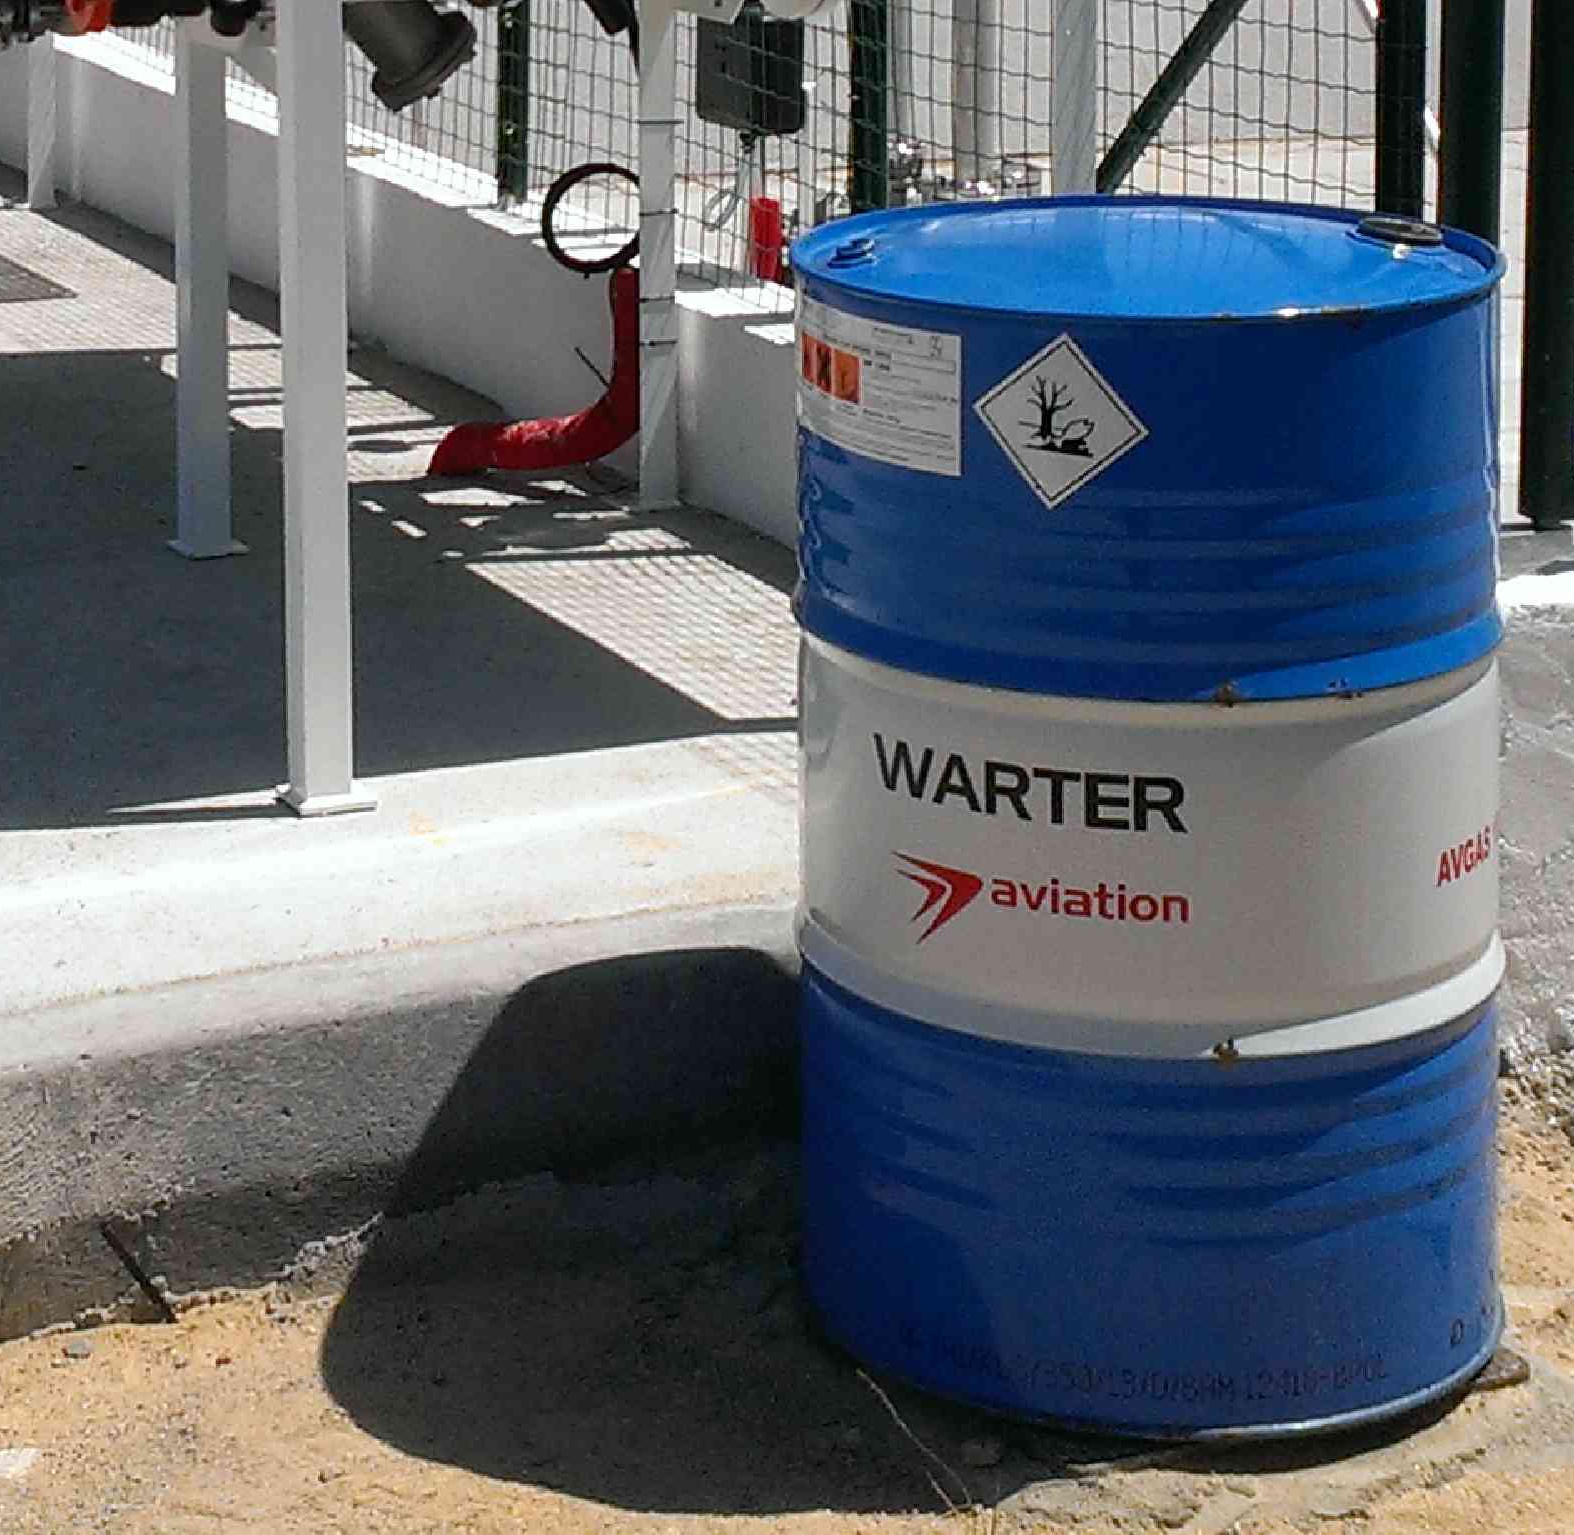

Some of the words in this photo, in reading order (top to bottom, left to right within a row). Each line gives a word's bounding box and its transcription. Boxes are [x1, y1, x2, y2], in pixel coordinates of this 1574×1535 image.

[873, 731, 1189, 834] WARTER
[1436, 824, 1491, 889] AVGAS
[990, 877, 1191, 924] aviation
